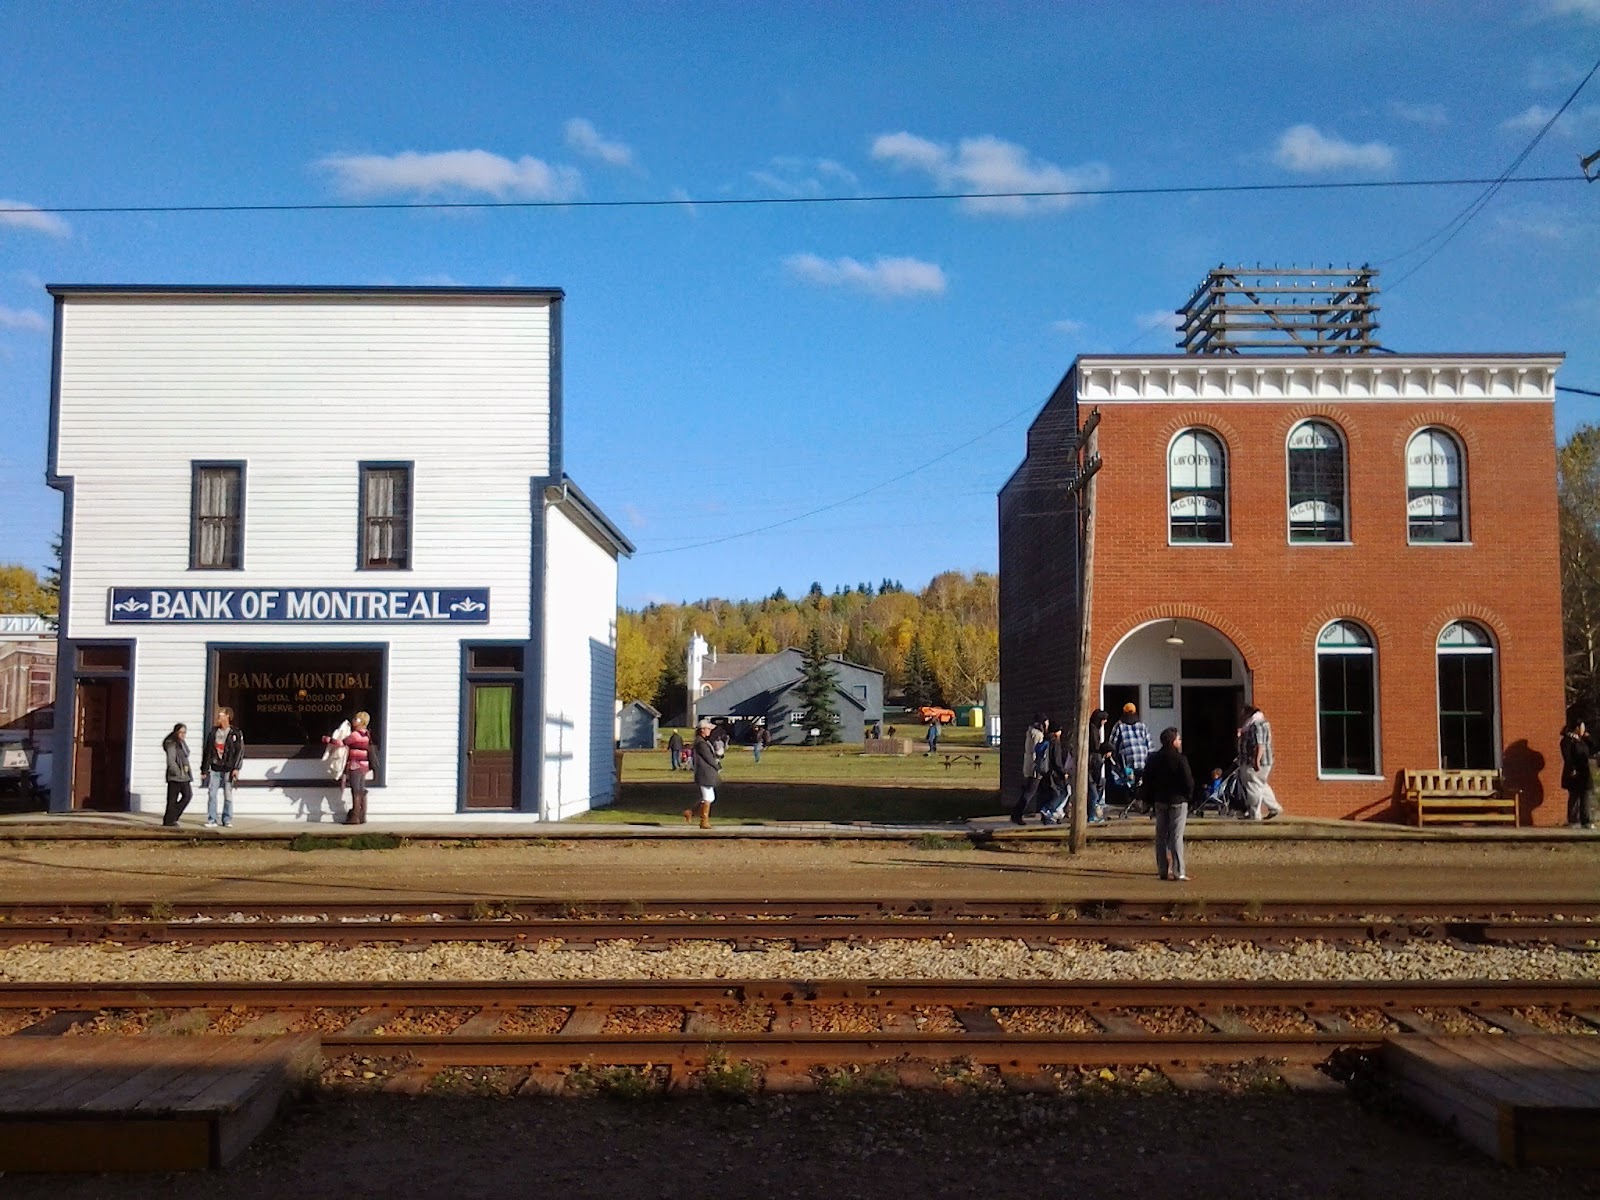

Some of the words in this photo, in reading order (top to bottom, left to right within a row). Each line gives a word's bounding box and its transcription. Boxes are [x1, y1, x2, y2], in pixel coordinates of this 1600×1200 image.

[1187, 498, 1218, 510] TAYLOR
[149, 590, 235, 620] BANK
[240, 590, 281, 620] OF
[286, 590, 451, 620] MONTREAL
[227, 672, 274, 689] BANK
[275, 672, 290, 689] of
[292, 672, 373, 689] MONTREAL
[256, 703, 293, 713] RESERVE
